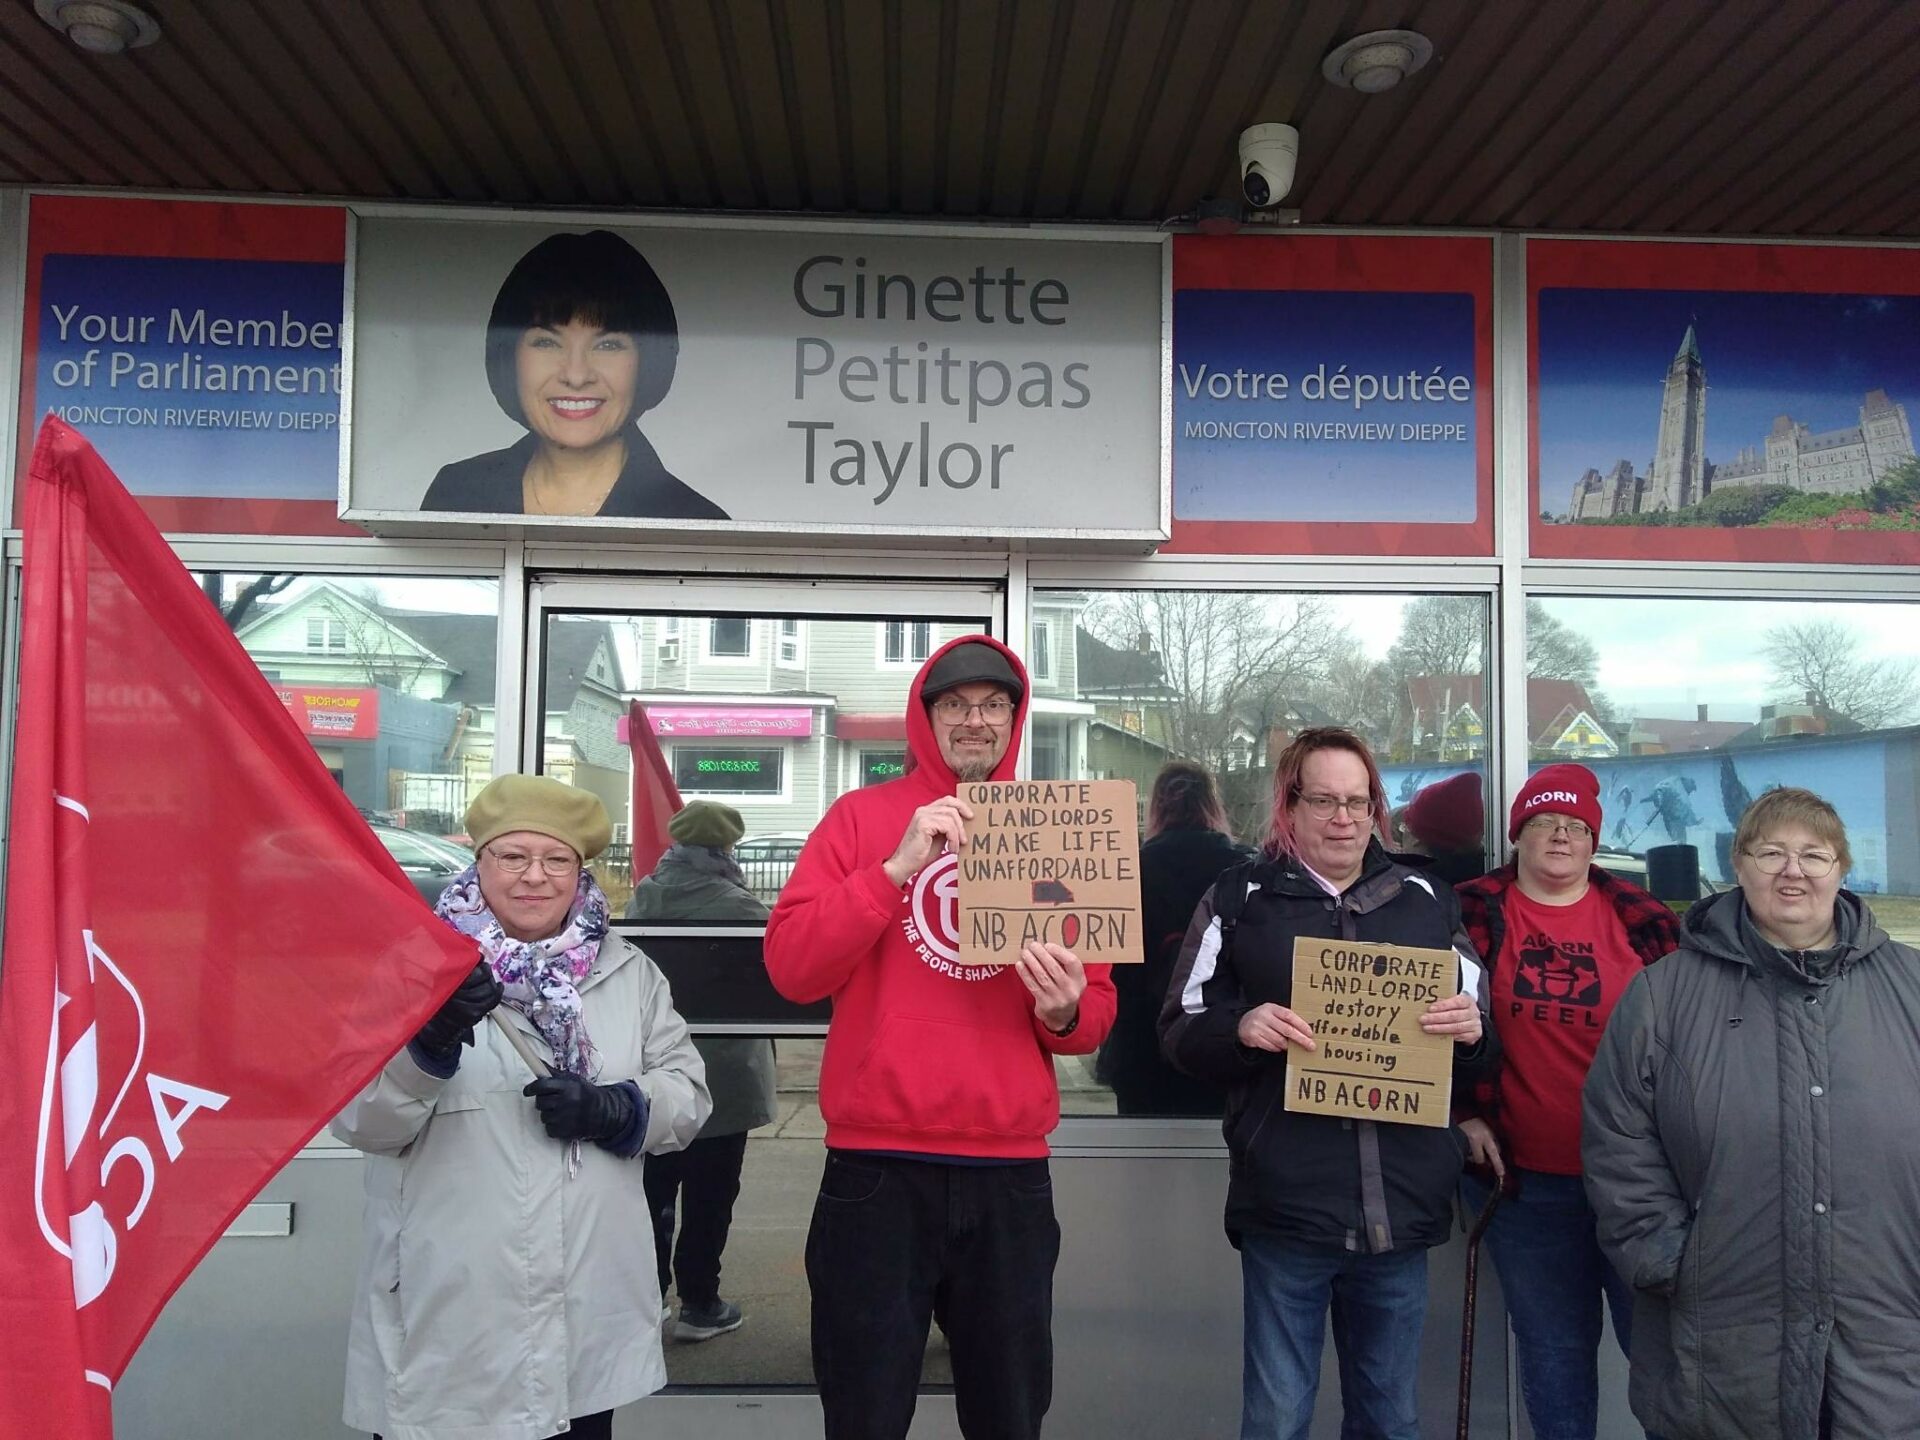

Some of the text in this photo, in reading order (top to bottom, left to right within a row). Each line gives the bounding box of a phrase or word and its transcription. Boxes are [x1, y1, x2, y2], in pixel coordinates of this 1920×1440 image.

[794, 254, 1070, 326] Ginette
[50, 304, 155, 344] Your
[52, 349, 342, 395] of Parliament
[795, 336, 1091, 423] Petitpas
[1179, 363, 1471, 409] Votre députée
[47, 405, 340, 431] MONCTON RIVERVIEW DIEPP
[1185, 421, 1466, 441] MONCTON RIVERVIEW DIEPPE
[788, 420, 1014, 504] Taylor
[968, 784, 1091, 804] CORPORATE
[1525, 790, 1578, 810] ACORN
[988, 807, 1113, 828] LANDLORDS
[972, 830, 1121, 855] MAKE LIFE
[964, 857, 1135, 882] UNAFFORDABLE
[972, 911, 1126, 952] NB ACORN
[901, 916, 1004, 981] THE PEOPLE SHALL
[1320, 948, 1444, 980] CORPORATE
[1310, 973, 1439, 1003] LANDLORDS
[1324, 998, 1401, 1027] destory
[1511, 1000, 1599, 1028] PEEL
[1324, 1042, 1397, 1072] housing
[1298, 1077, 1420, 1115] NB ACORN
